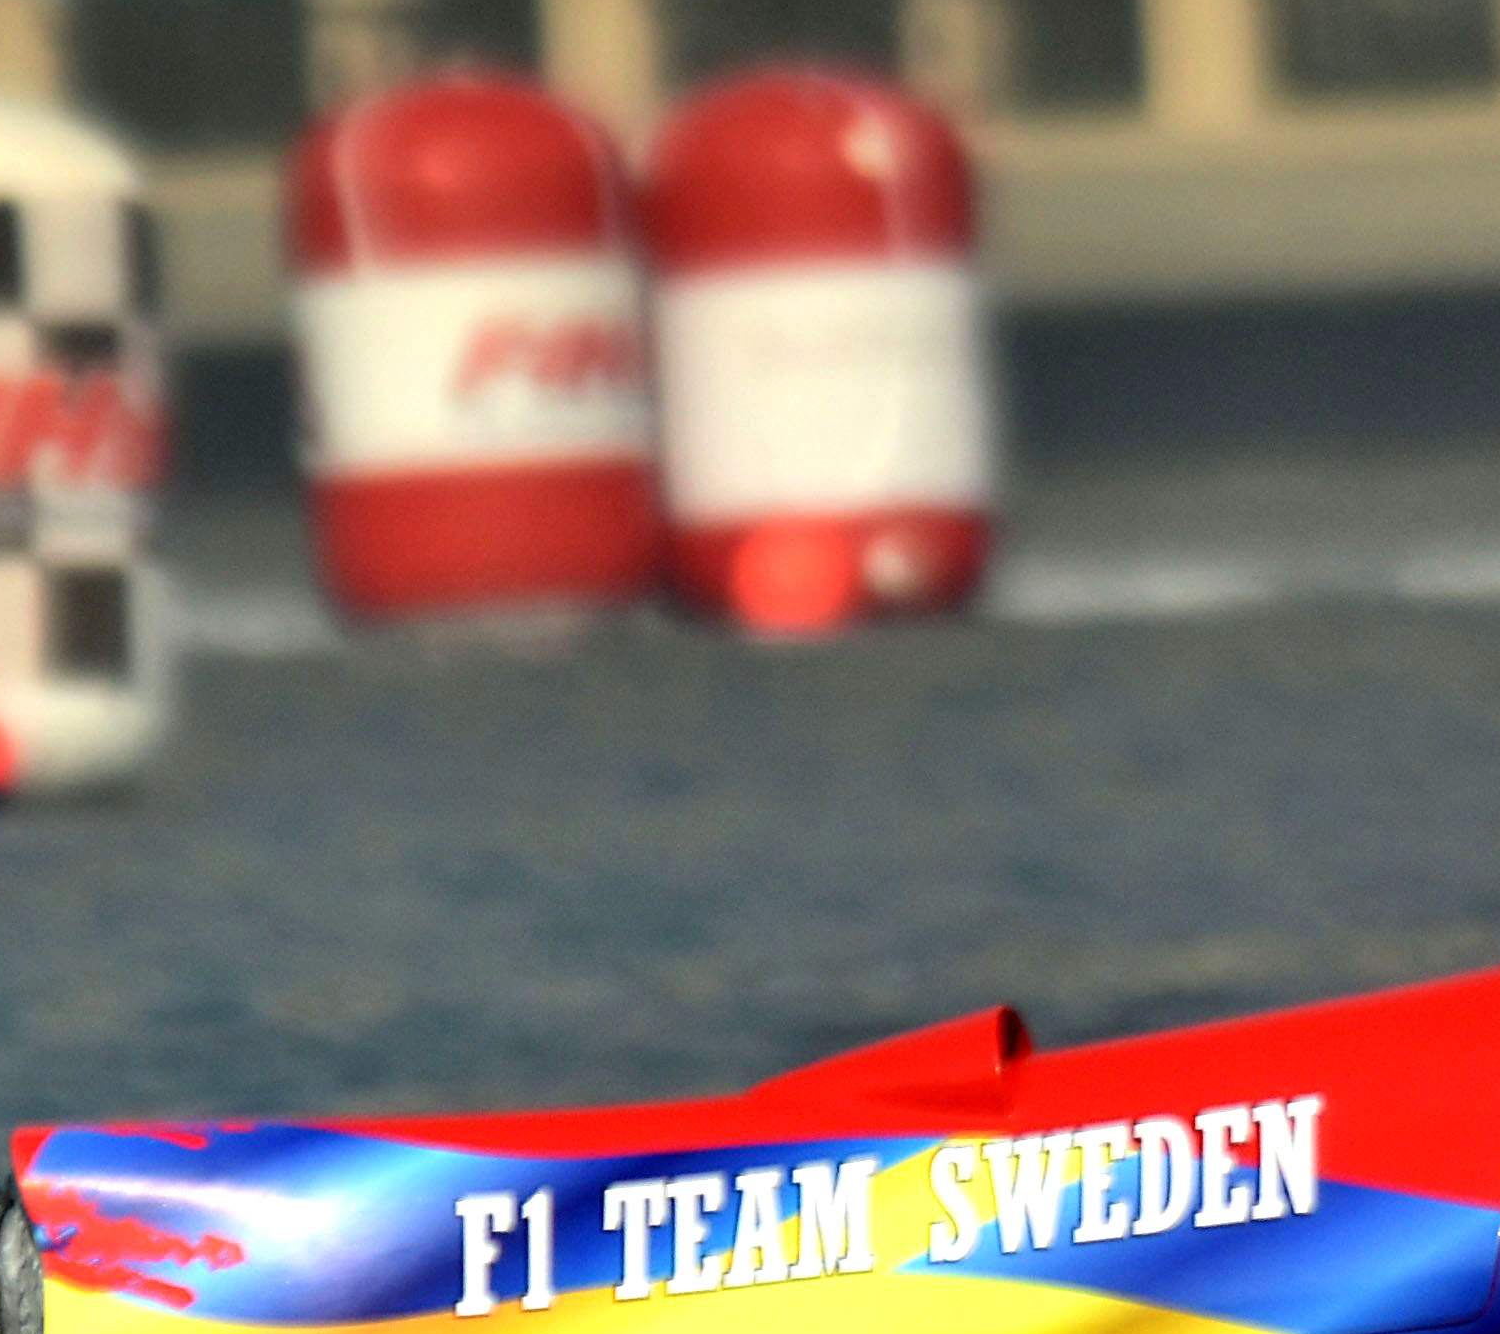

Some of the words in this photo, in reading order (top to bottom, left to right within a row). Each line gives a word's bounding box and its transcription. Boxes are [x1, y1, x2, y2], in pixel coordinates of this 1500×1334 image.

[454, 1187, 555, 1318] F1
[603, 1156, 879, 1303] TEAM
[927, 1094, 1324, 1265] SWEDEN
